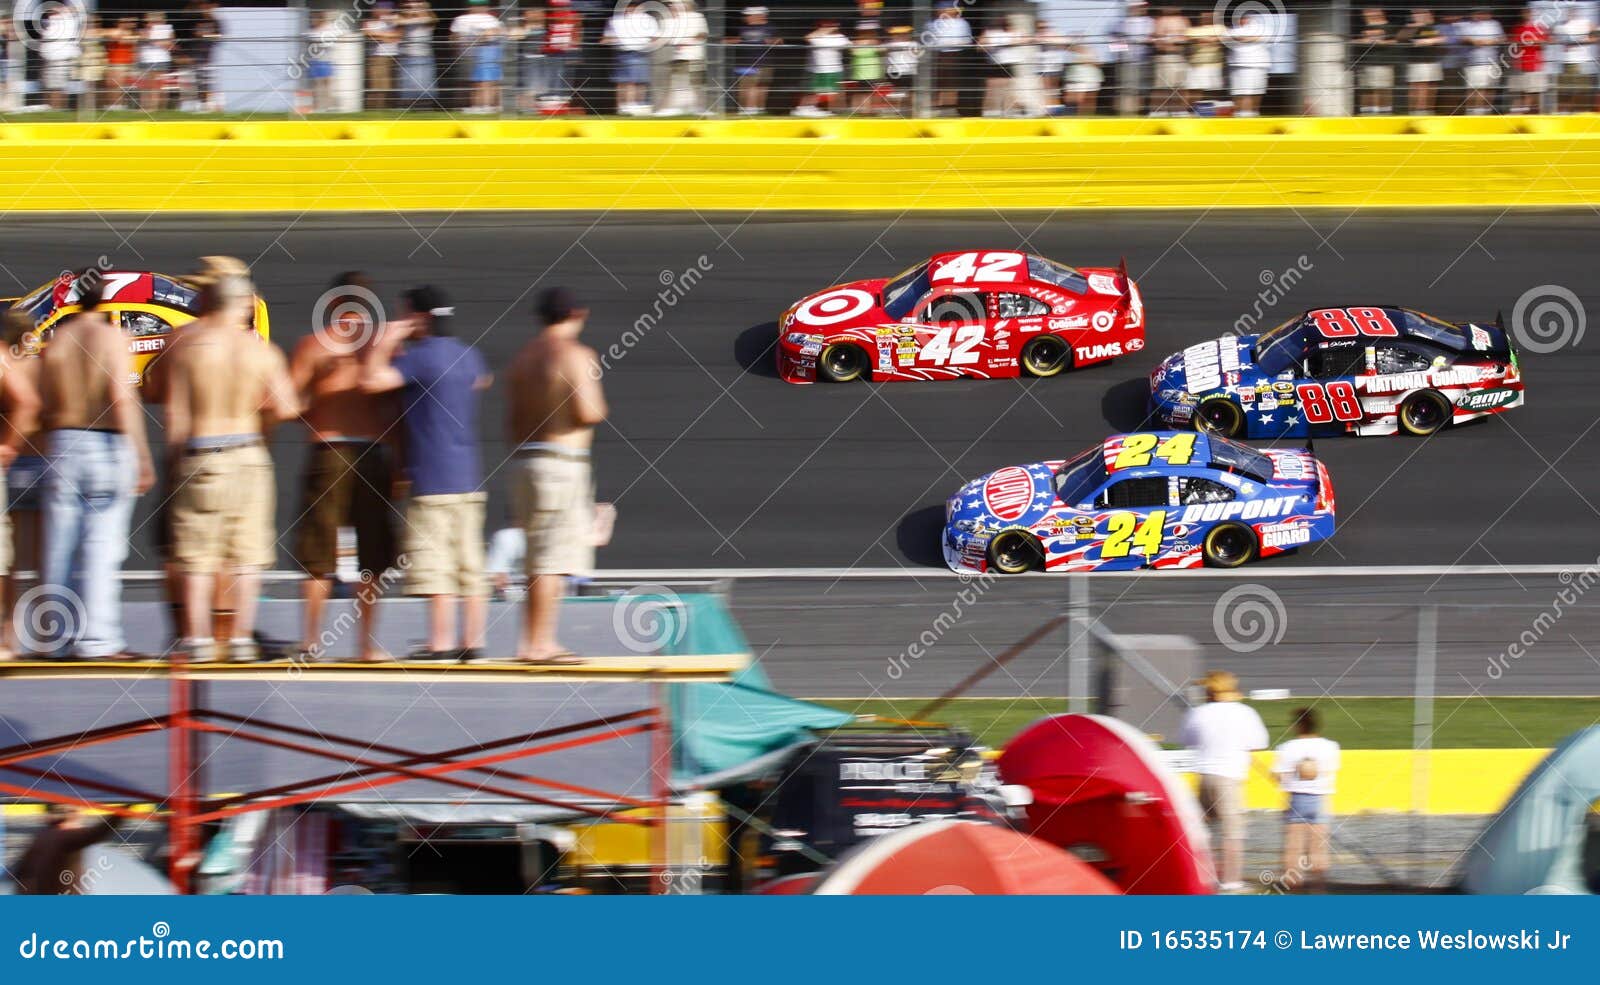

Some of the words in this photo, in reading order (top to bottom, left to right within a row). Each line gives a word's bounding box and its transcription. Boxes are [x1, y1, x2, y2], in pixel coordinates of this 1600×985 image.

[932, 252, 1023, 283] 42
[1307, 307, 1399, 337] 88
[918, 324, 985, 366] 42
[1366, 371, 1431, 393] NATIONAL
[1296, 380, 1363, 424] 88
[1114, 433, 1197, 469] 24
[1181, 495, 1300, 523] DUPONT
[1101, 510, 1167, 558] 24
[1263, 528, 1310, 547] GUARD
